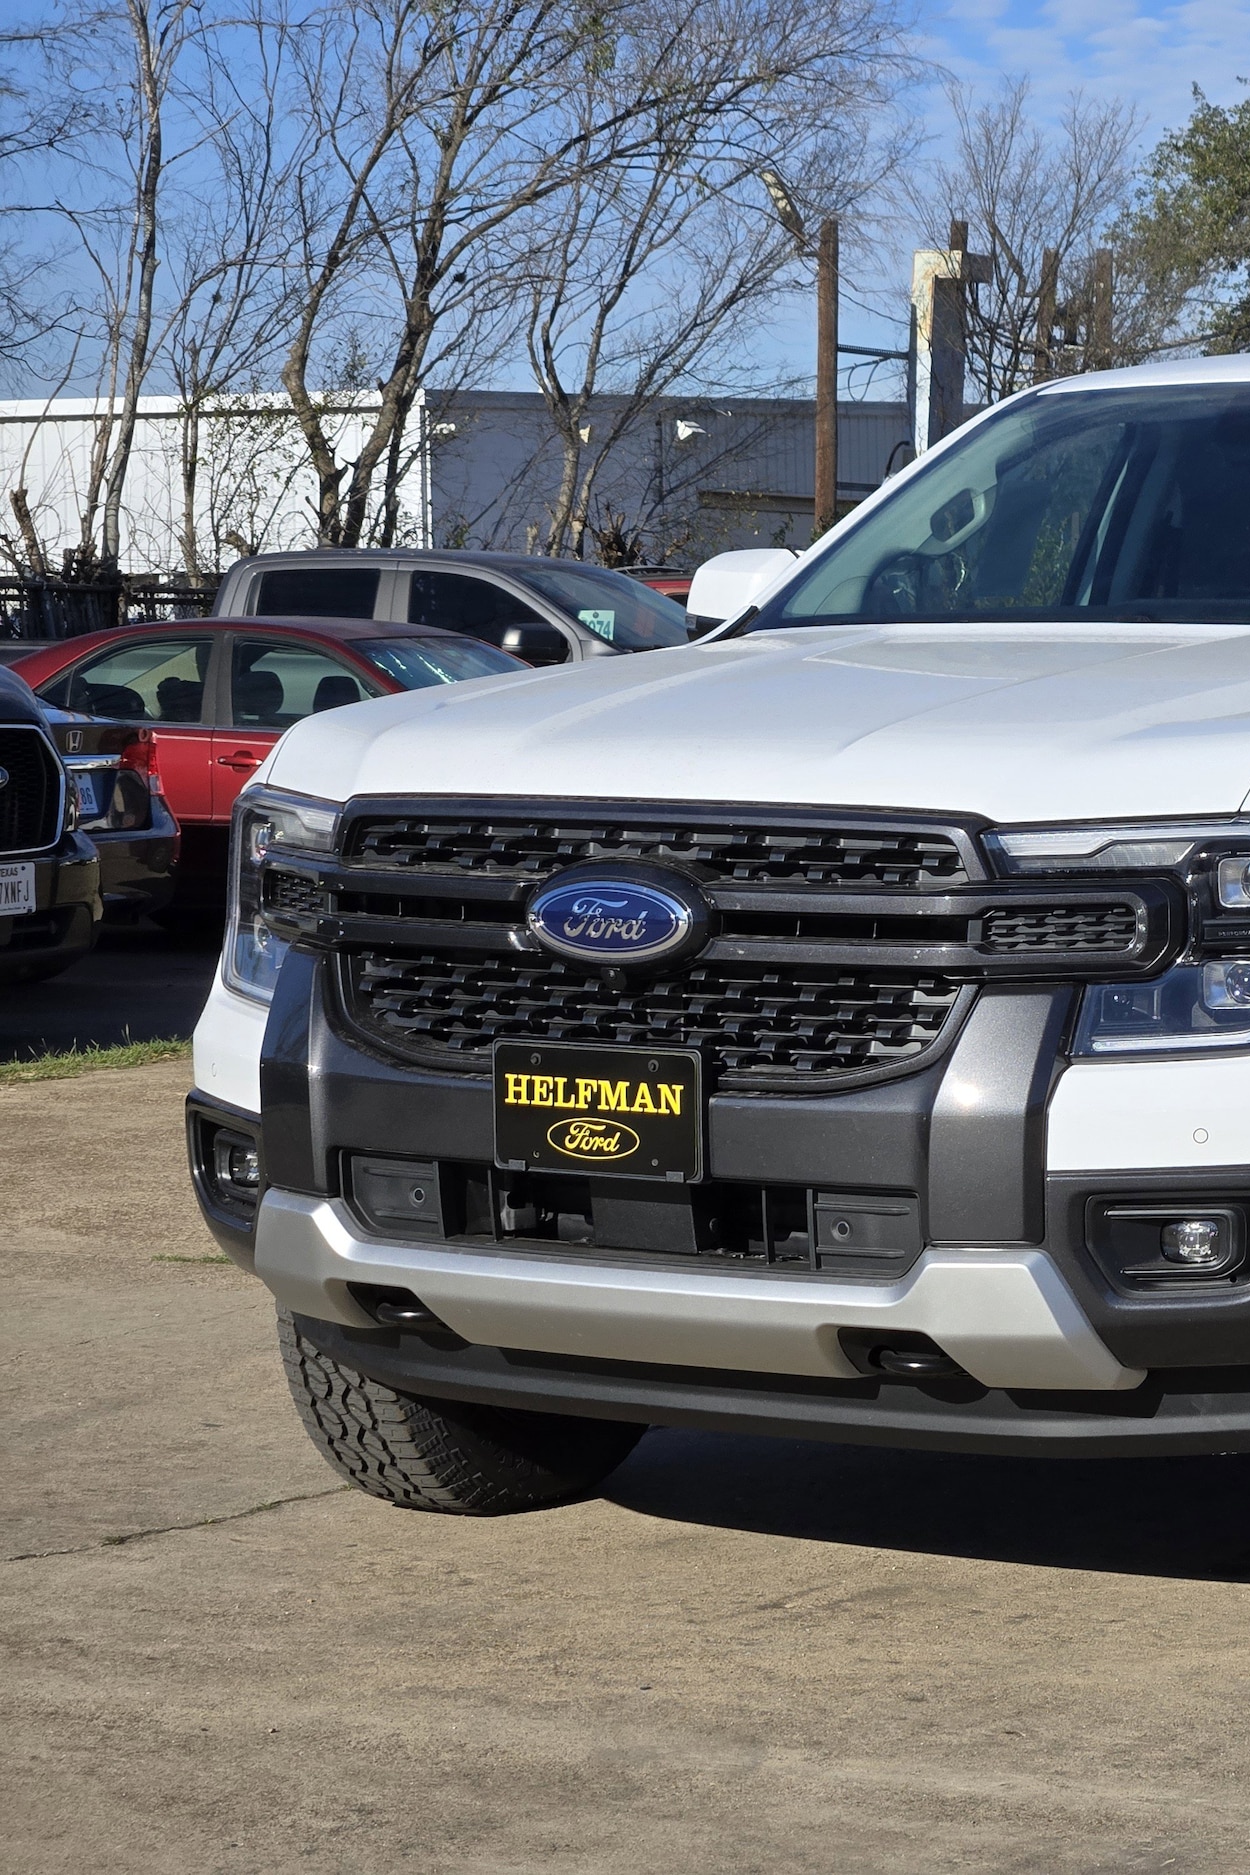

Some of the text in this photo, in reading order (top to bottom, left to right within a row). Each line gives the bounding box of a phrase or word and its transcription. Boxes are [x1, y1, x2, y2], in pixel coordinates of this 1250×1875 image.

[563, 897, 648, 941] Ford
[504, 1073, 684, 1116] HELFMAN
[564, 1121, 621, 1152] Ford
